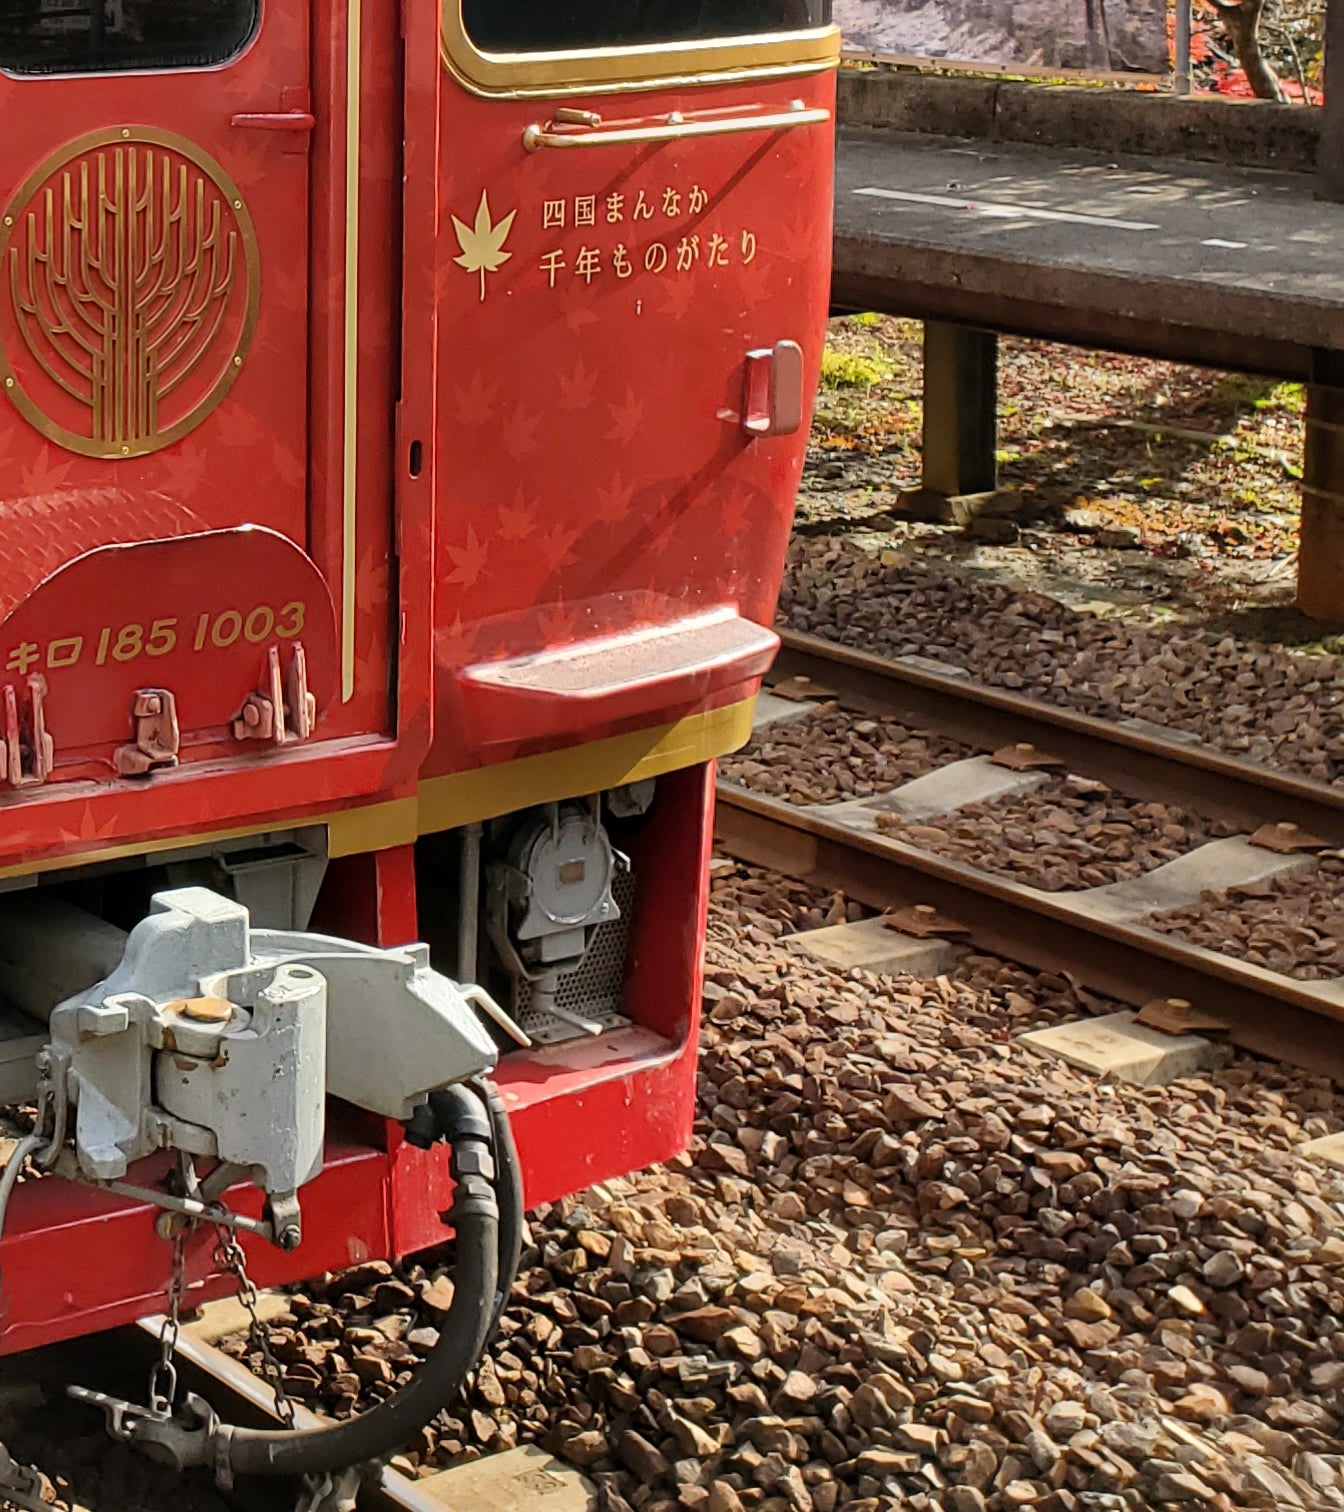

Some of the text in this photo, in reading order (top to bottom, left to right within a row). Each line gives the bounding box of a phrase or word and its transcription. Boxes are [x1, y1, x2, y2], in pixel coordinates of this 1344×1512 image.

[542, 184, 709, 229] 四国まんなか
[538, 229, 757, 288] 千年ものがたり
[193, 601, 306, 651] 1003
